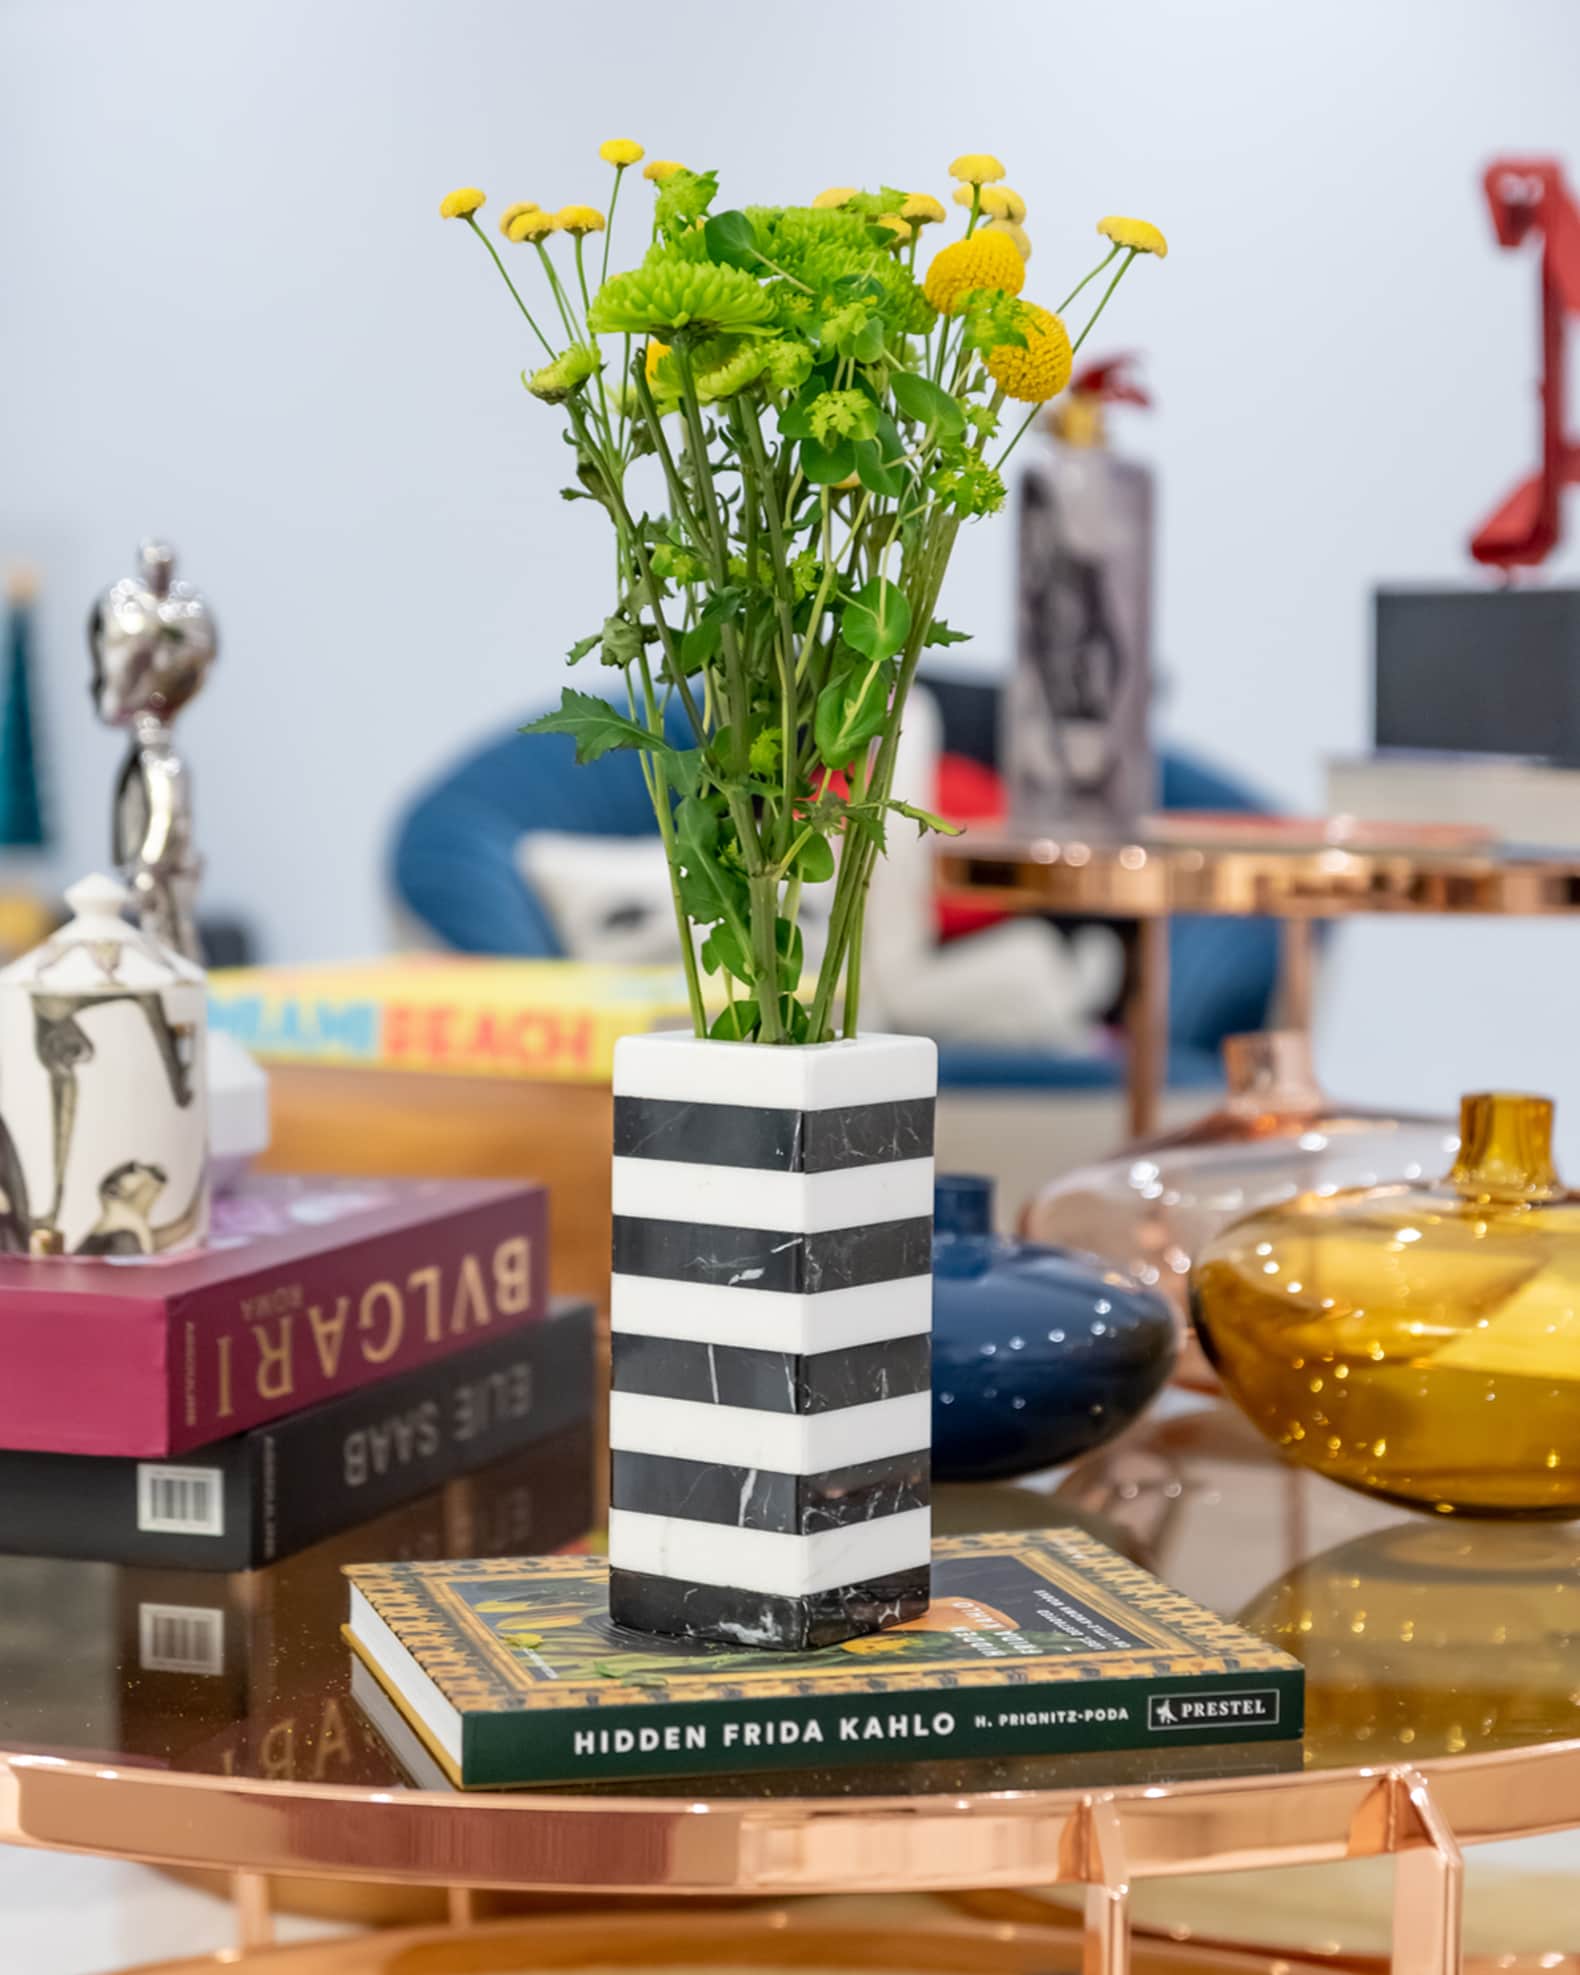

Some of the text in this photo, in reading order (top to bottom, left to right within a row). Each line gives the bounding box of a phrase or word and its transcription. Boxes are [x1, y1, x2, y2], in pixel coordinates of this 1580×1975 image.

[384, 1001, 593, 1067] BEACH
[217, 1236, 531, 1416] BVLGARI
[343, 1402, 438, 1486] SAAB
[951, 1601, 1044, 1654] FRIDA KAHLO
[574, 1711, 955, 1755] HIDDEN FRIDA KAHLO
[975, 1708, 1129, 1728] H. PRIGNITZ-PODA
[1181, 1699, 1266, 1718] PRESTEL
